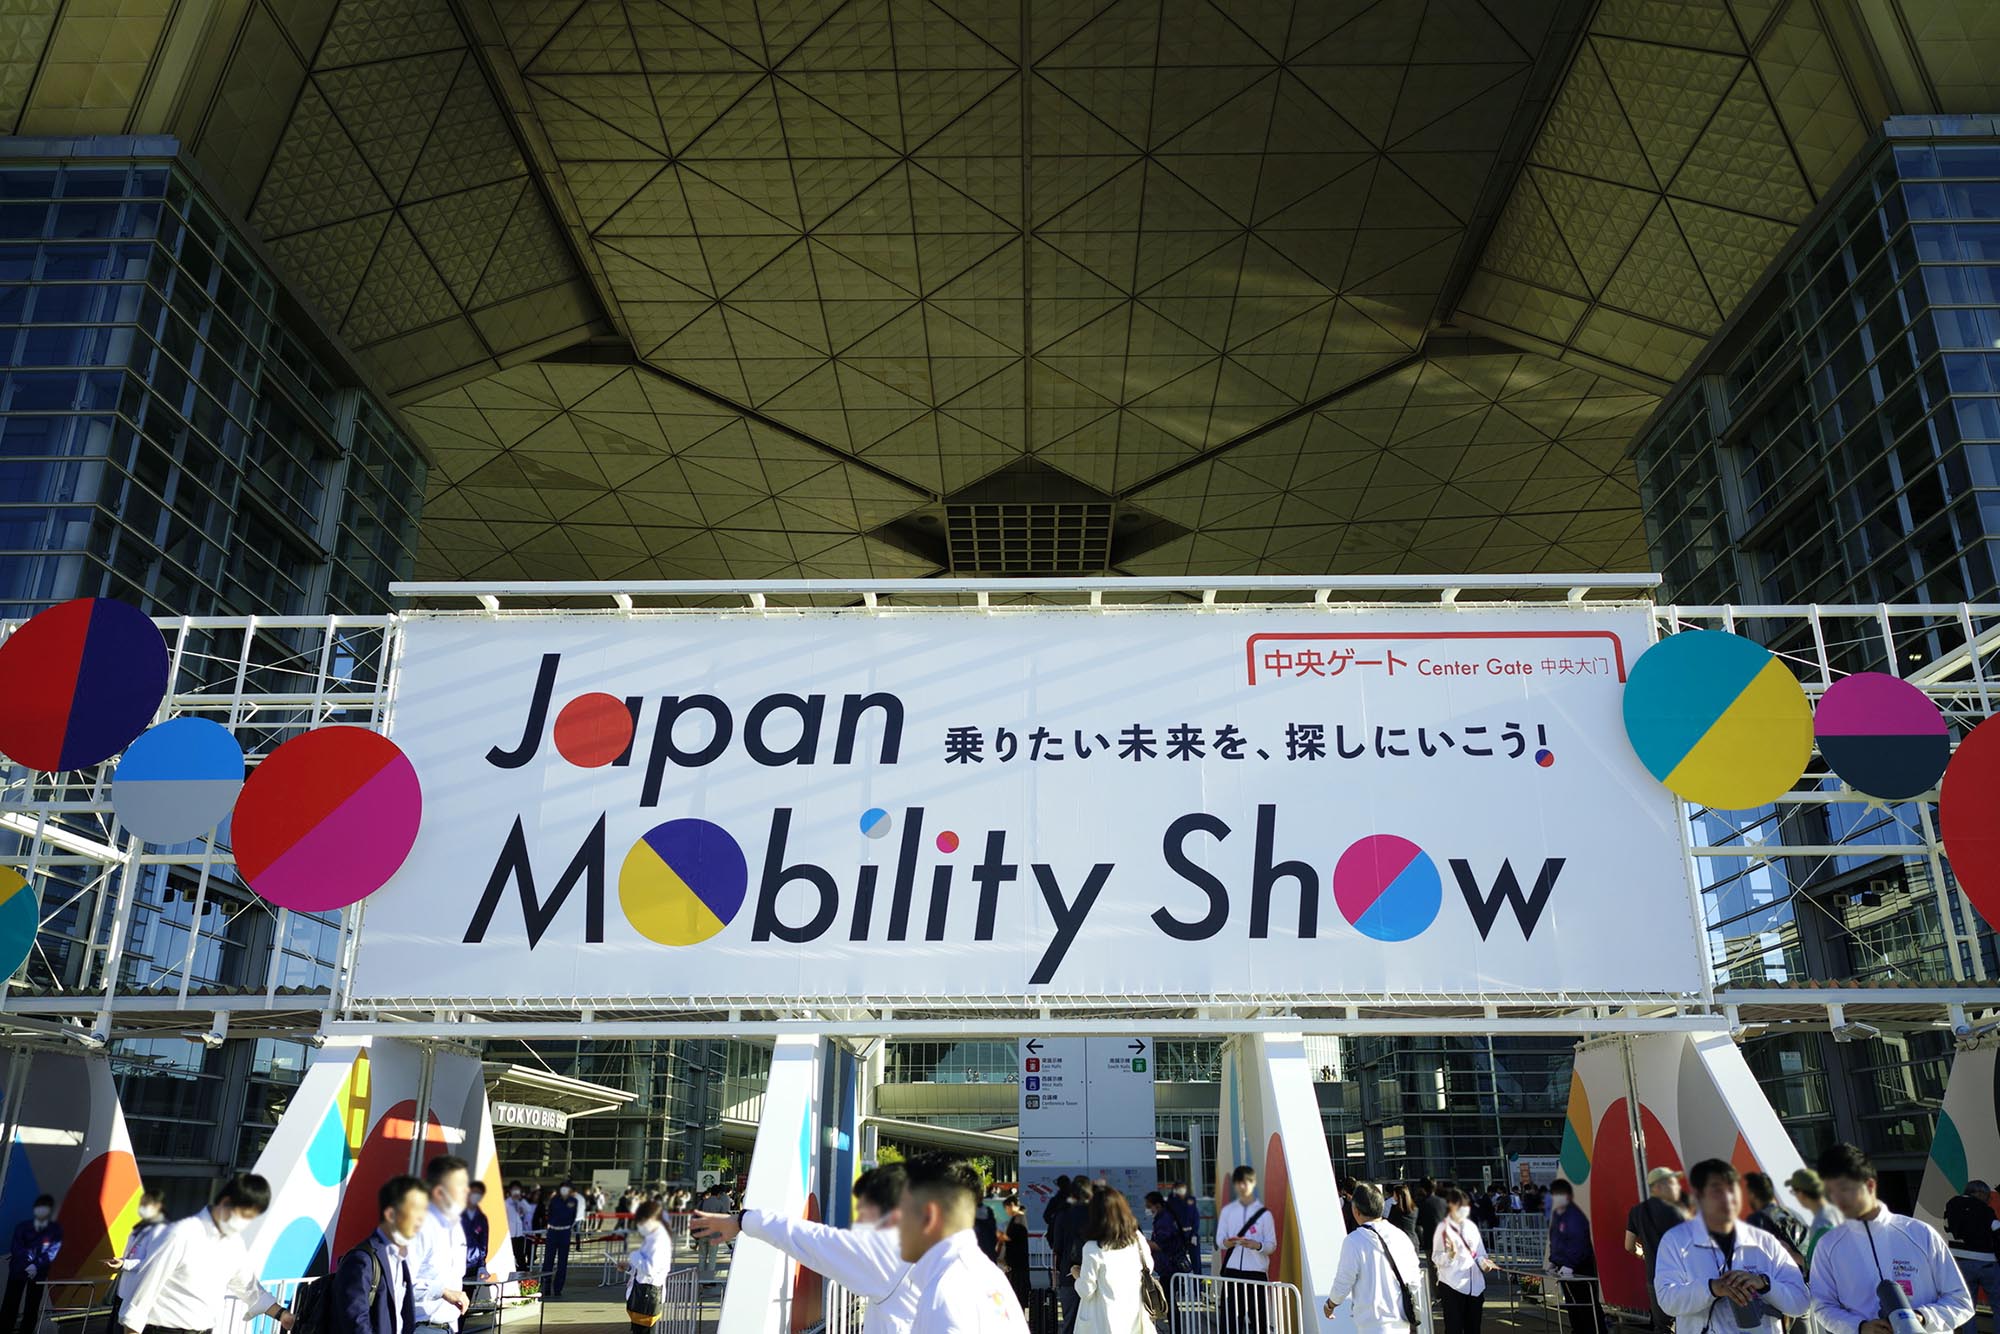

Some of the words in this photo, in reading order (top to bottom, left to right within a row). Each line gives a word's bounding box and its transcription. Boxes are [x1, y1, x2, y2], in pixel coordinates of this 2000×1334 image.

[1264, 648, 1408, 678] 中央ゲート
[1417, 659, 1479, 677] Center
[1486, 658, 1533, 676] Gate
[1540, 657, 1609, 675] 中央大门
[485, 653, 905, 807] Japan
[462, 807, 1115, 985] Mobility
[1150, 803, 1567, 943] Show
[497, 1105, 540, 1126] TOKYO
[541, 1110, 555, 1128] BIG
